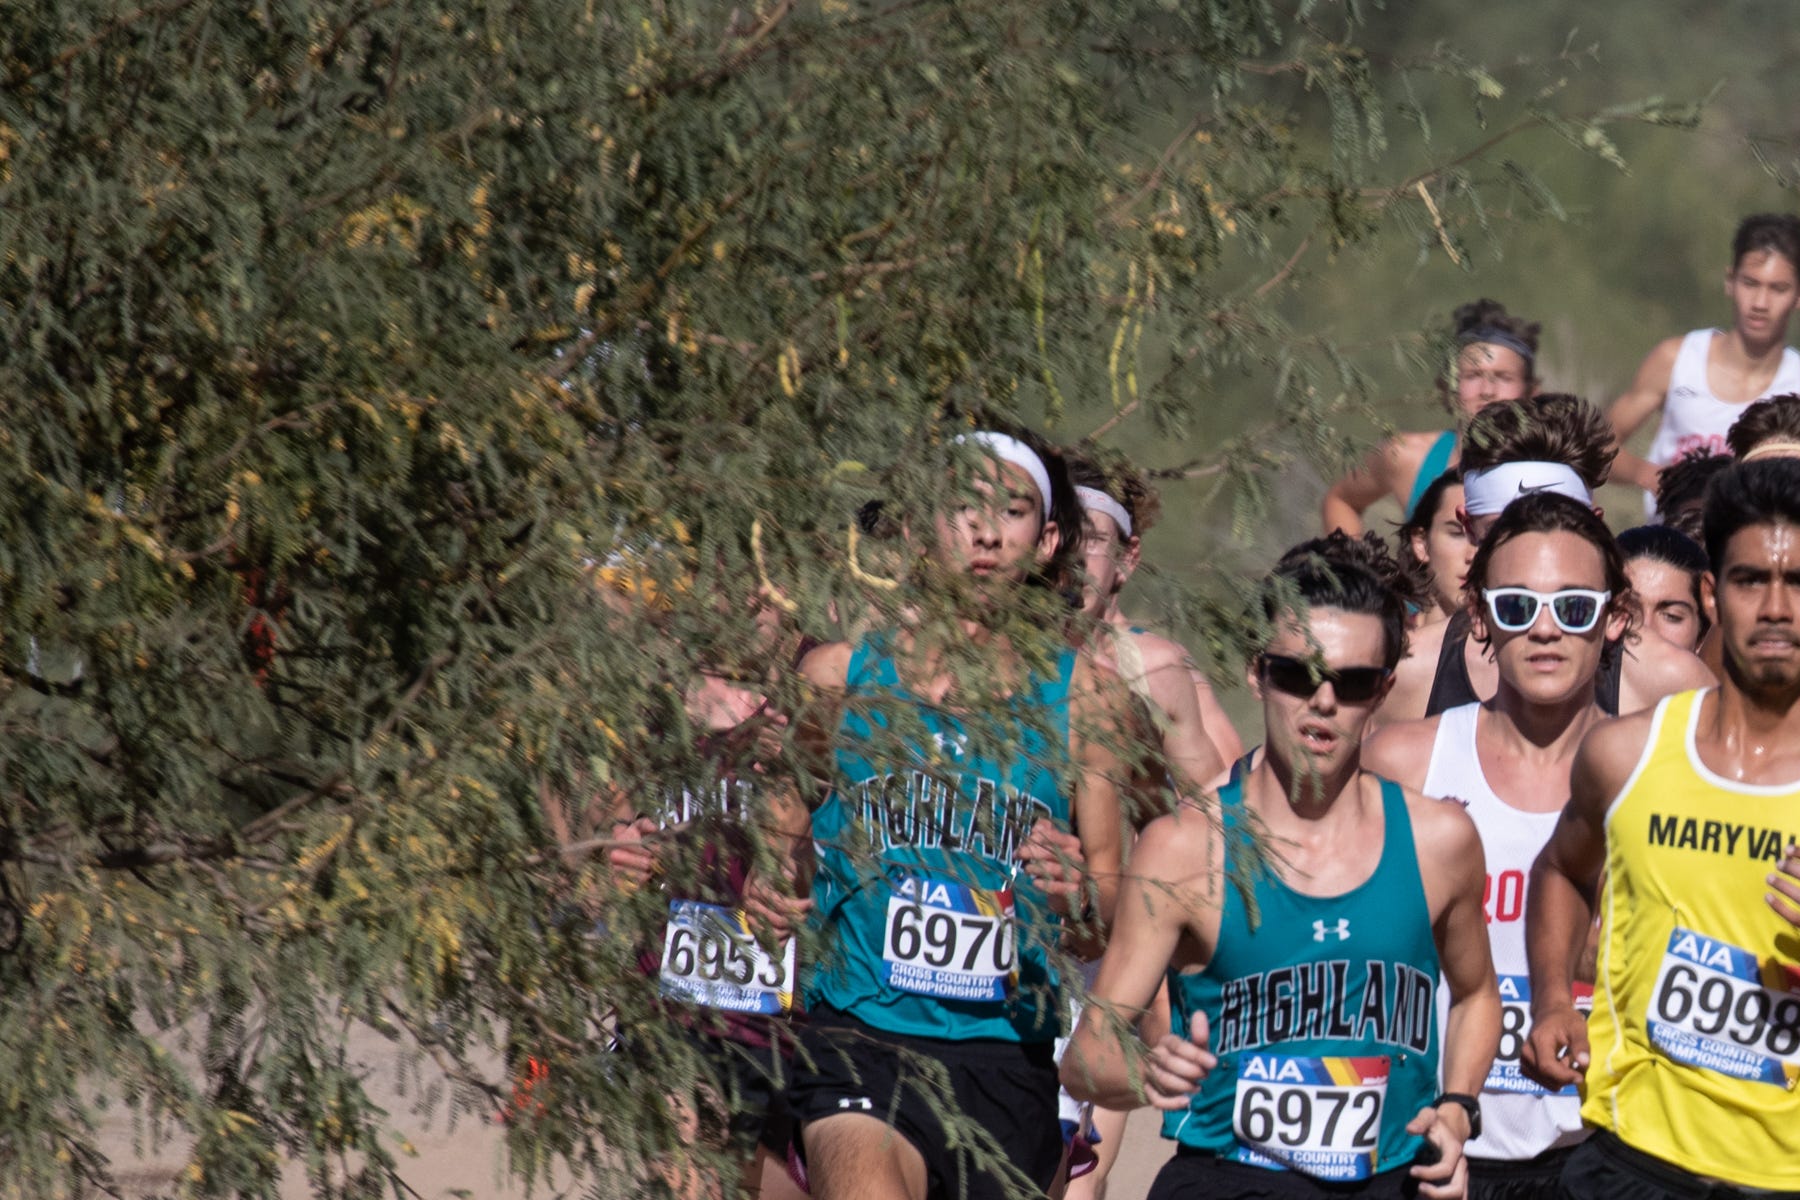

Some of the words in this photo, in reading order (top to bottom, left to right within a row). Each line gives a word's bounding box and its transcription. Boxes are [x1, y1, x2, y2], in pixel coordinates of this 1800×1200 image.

[899, 877, 951, 908] AIA
[891, 905, 1014, 971] 6970
[1672, 935, 1735, 974] AIA
[890, 974, 994, 998] CHAMPIONSHIPS
[891, 963, 932, 980] CROSS
[936, 970, 995, 988] COUNTRY
[1216, 960, 1433, 1056] HIGHLAND
[1652, 1036, 1763, 1080] CHAMPIONSHIPS
[1653, 1024, 1698, 1047] CROSS
[1701, 1039, 1765, 1066] COUNTRY
[1244, 1056, 1304, 1082] AIA
[1240, 1086, 1382, 1148] 6972
[1292, 1150, 1357, 1165] COUNTRY
